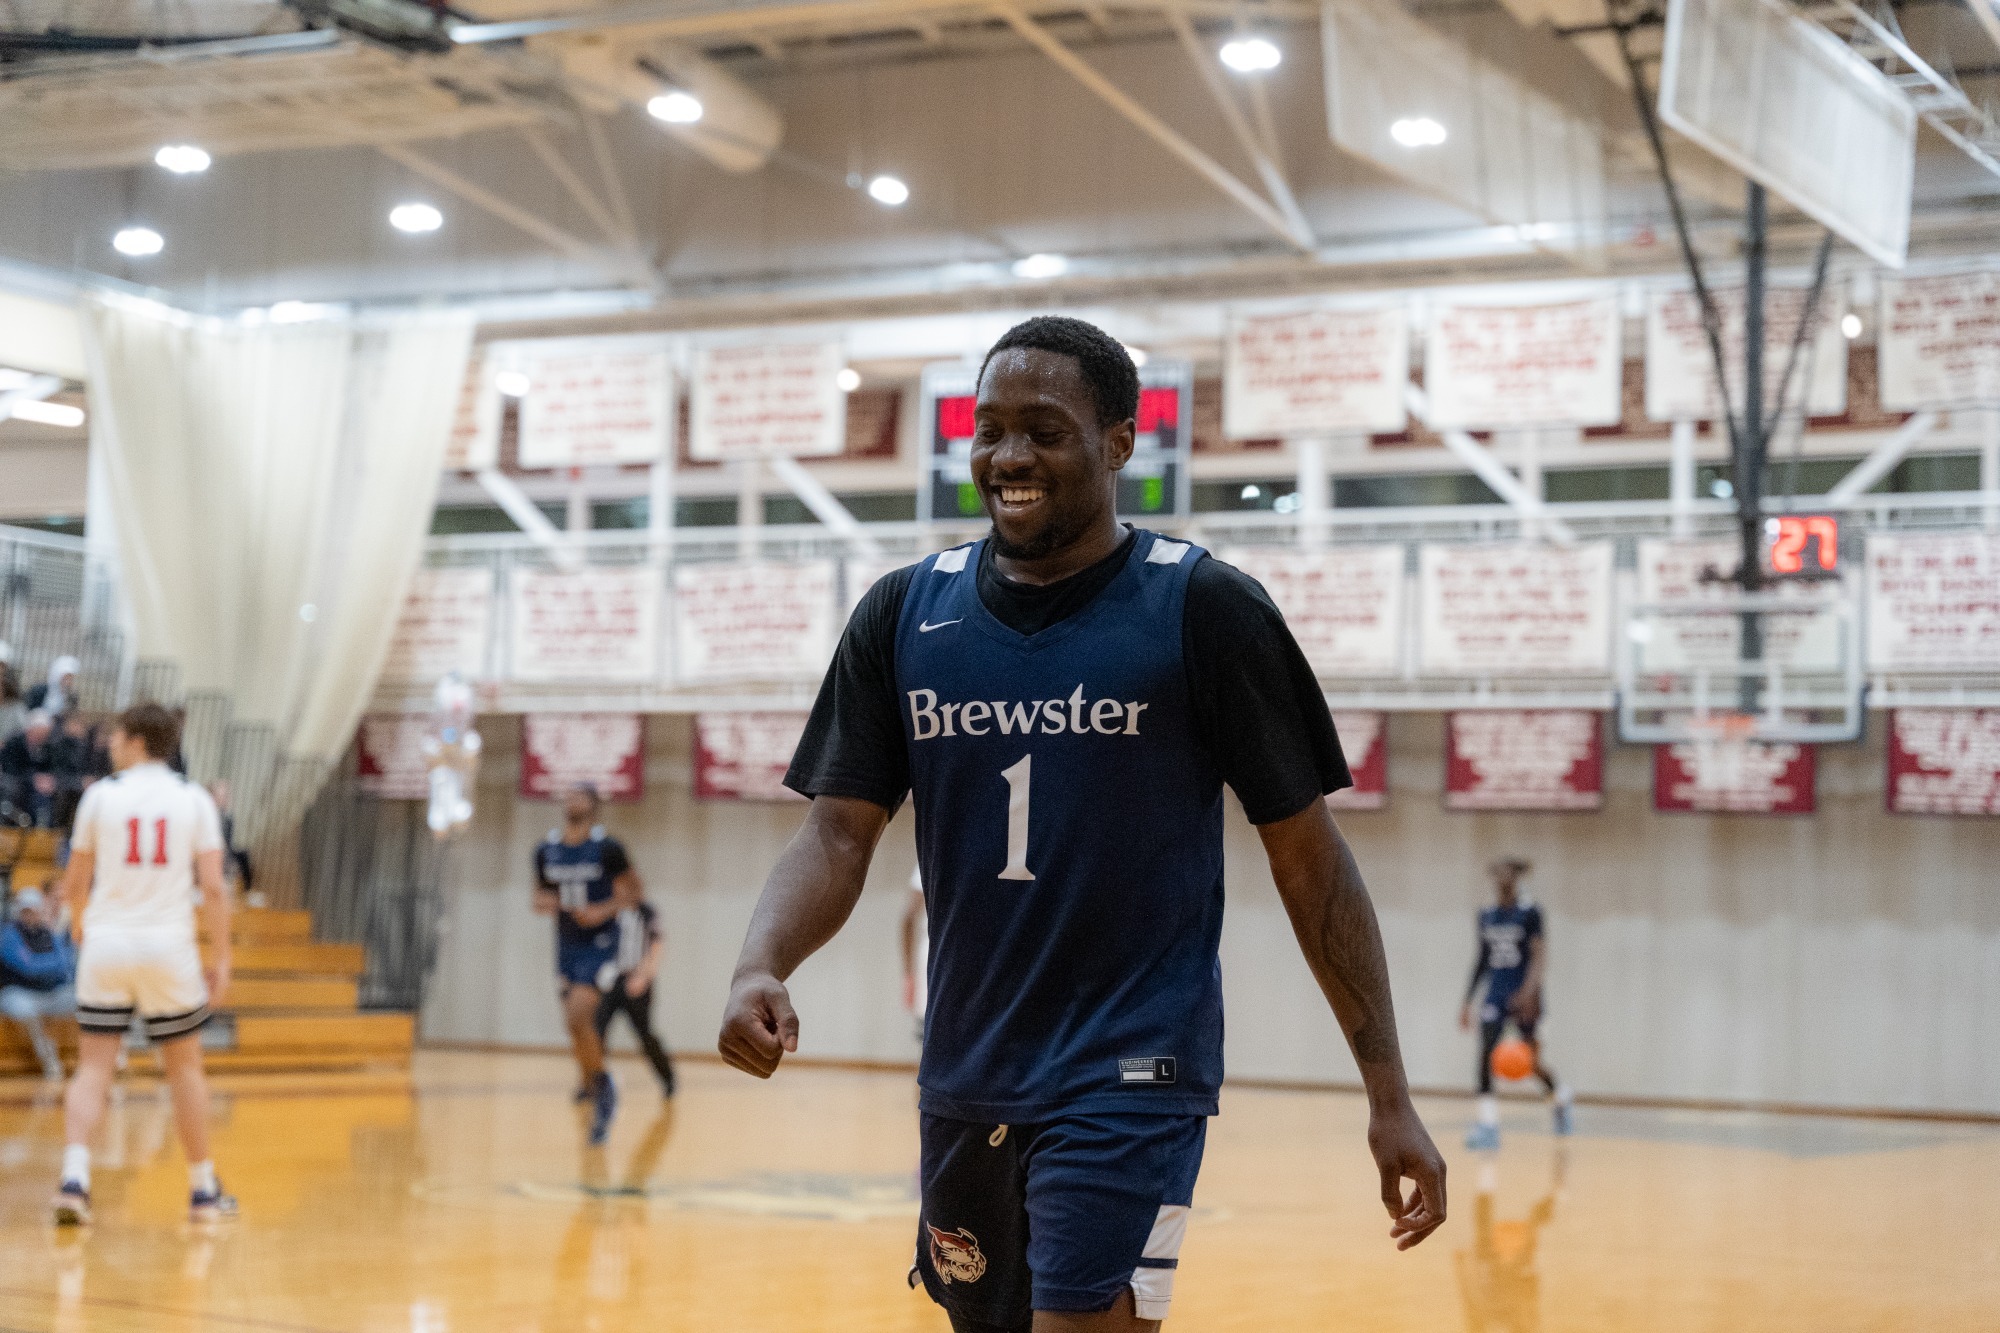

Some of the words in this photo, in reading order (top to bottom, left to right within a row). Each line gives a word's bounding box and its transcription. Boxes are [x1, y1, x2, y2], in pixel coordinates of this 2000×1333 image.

[1770, 516, 1838, 573] 27
[907, 682, 1149, 741] Brewster
[126, 817, 168, 865] 11
[998, 753, 1036, 881] 1
[1162, 1064, 1169, 1076] L
